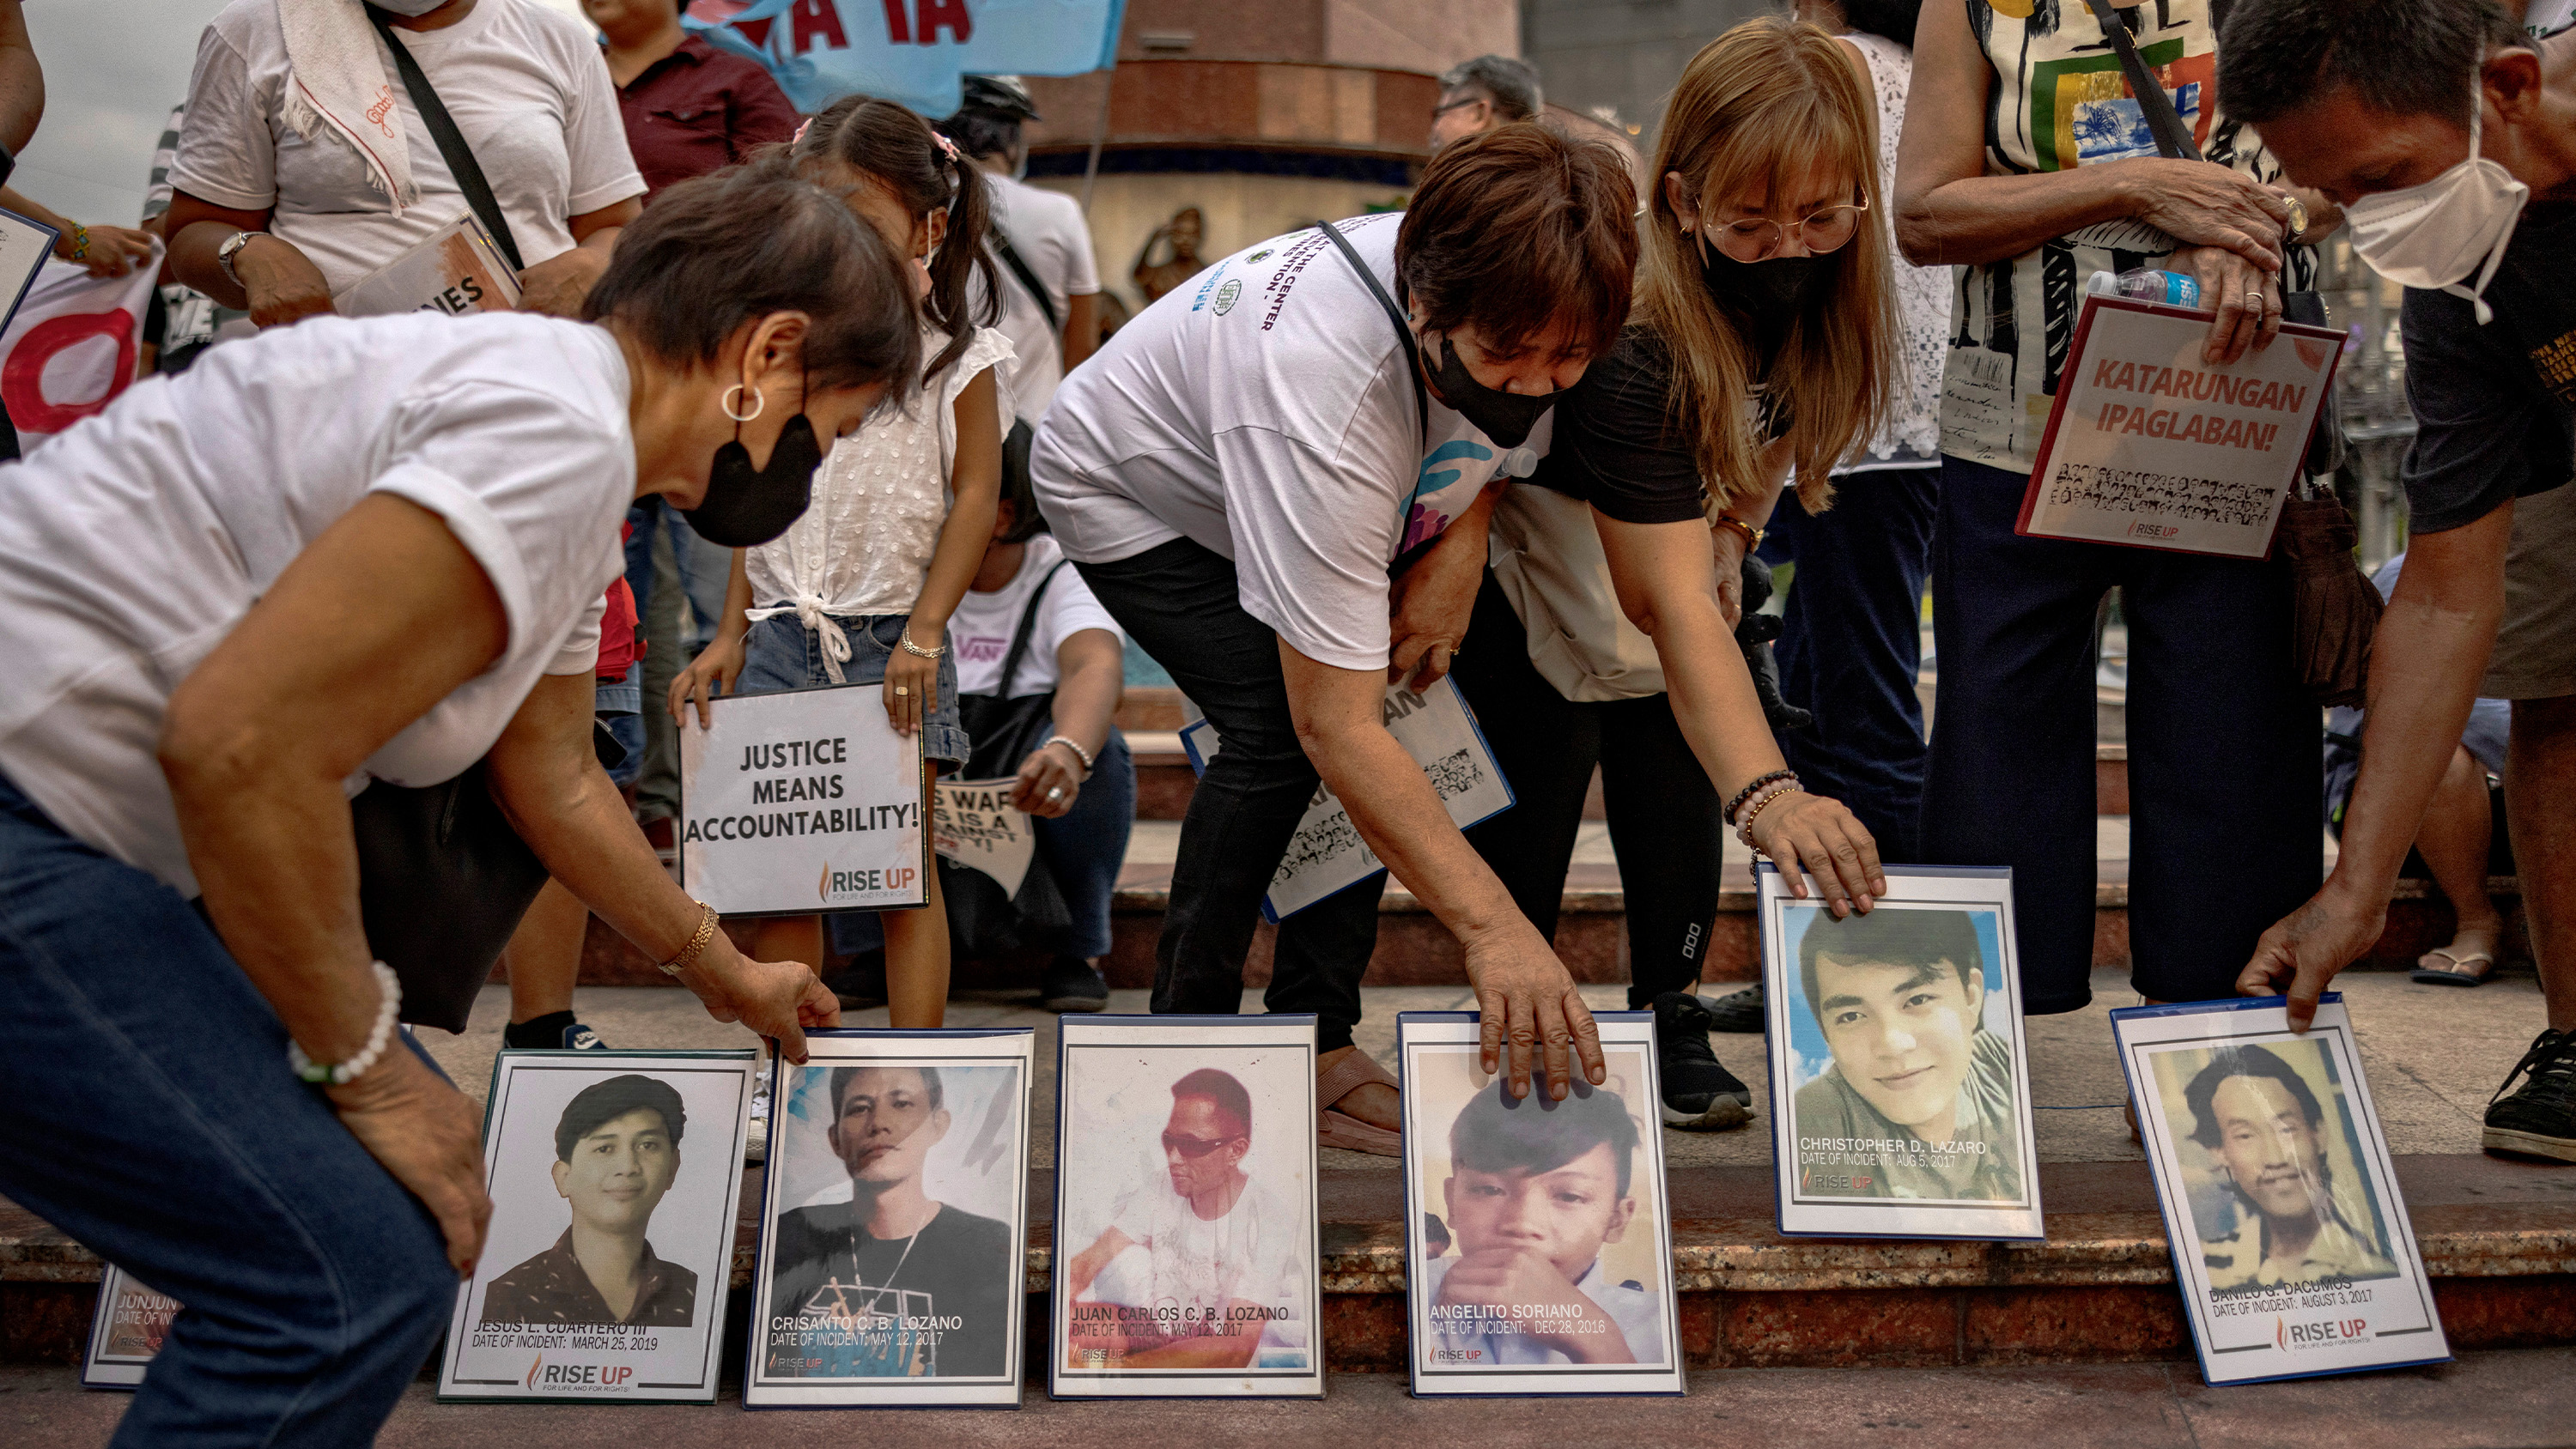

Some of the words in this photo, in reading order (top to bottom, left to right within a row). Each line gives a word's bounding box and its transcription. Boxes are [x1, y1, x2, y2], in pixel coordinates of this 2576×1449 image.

[1267, 235, 1329, 291] REVENTION
[1291, 252, 1317, 273] THE
[2179, 279, 2193, 307] ESH
[1261, 276, 1296, 331] CENTER
[2093, 359, 2307, 414] KATARUNGAN
[2096, 403, 2279, 452] IPAGLABAN!
[2136, 524, 2162, 536] RISE
[2163, 526, 2178, 537] UP
[956, 634, 1006, 663] VAN
[740, 737, 847, 772] JUSTICE
[753, 774, 844, 804] MEANS
[684, 803, 919, 843] ACCOUNTABILITY!
[993, 815, 1009, 831] A
[833, 870, 881, 892] RISE
[885, 868, 915, 889] UP
[1801, 1137, 1905, 1153] CHRISTOPHER
[1911, 1140, 1925, 1153] D.
[1930, 1141, 1986, 1155] LAZARO
[1801, 1152, 1826, 1165] DATE
[1828, 1153, 1842, 1165] OF
[1844, 1153, 1892, 1167] INCIDENT:
[1896, 1155, 1917, 1167] AUG
[1918, 1155, 1929, 1168] 5,
[1931, 1155, 1956, 1167] 2017
[1814, 1175, 1849, 1188] RISE
[1852, 1176, 1873, 1189] UP
[2208, 1285, 2261, 1303] DANILO
[2265, 1283, 2280, 1298] G.
[2283, 1276, 2353, 1296] DACUMOS
[118, 1295, 177, 1310] JUNJUN
[2213, 1301, 2237, 1318] DATE
[2239, 1300, 2251, 1315] OF
[2253, 1296, 2298, 1314] INCIDENT:
[2301, 1292, 2337, 1309] AUGUST
[2339, 1291, 2348, 1307] 3,
[2350, 1289, 2372, 1304] 2017
[116, 1311, 143, 1325] DATE
[144, 1312, 158, 1325] OF
[1072, 1307, 1112, 1321] JUAN
[1117, 1307, 1180, 1321] CARLOS
[1185, 1307, 1200, 1321] C.
[1206, 1307, 1220, 1321] B.
[1226, 1307, 1289, 1321] LOZANO
[1430, 1305, 1507, 1319] ANGELITO
[1512, 1304, 1583, 1319] SORIANO
[474, 1319, 523, 1333] JESUS
[527, 1320, 540, 1333] L.
[546, 1320, 629, 1335] CUARTERO
[633, 1322, 647, 1335] III
[773, 1316, 852, 1331] CRISANTO
[857, 1317, 872, 1331] C.
[878, 1317, 892, 1331] B.
[899, 1316, 963, 1330] LOZANO
[1072, 1324, 1098, 1337] DATE
[1101, 1324, 1115, 1337] OF
[1118, 1324, 1169, 1337] INCIDENT:
[1171, 1324, 1194, 1337] MAY
[1197, 1324, 1212, 1338] 12,
[1216, 1324, 1242, 1337] 2017
[1431, 1321, 1457, 1335] DATE
[1460, 1321, 1473, 1334] OF
[1476, 1320, 1526, 1334] INCIDENT:
[1534, 1320, 1556, 1334] DEC
[1558, 1320, 1575, 1336] 28,
[1577, 1319, 1606, 1334] 2016
[2290, 1322, 2337, 1343] RISE
[2339, 1319, 2366, 1338] UP
[120, 1337, 146, 1347] RISE
[147, 1337, 162, 1347] UP
[472, 1335, 498, 1348] DATE
[501, 1335, 514, 1348] OF
[516, 1335, 567, 1349] INCIDENT:
[571, 1337, 610, 1350] MARCH
[611, 1337, 628, 1352] 25,
[630, 1337, 659, 1351] 2019
[771, 1332, 798, 1346] DATE
[800, 1332, 815, 1345] OF
[817, 1332, 869, 1346] INCIDENT:
[871, 1332, 893, 1345] MAY
[896, 1332, 912, 1348] 12,
[915, 1332, 944, 1345] 2017
[1081, 1349, 1107, 1359] RISE
[1109, 1349, 1124, 1359] UP
[1438, 1350, 1463, 1360] RISE
[1466, 1350, 1482, 1360] UP
[778, 1358, 804, 1368] RISE
[806, 1359, 823, 1368] UP
[544, 1365, 598, 1384] RISE
[601, 1367, 633, 1385] UP
